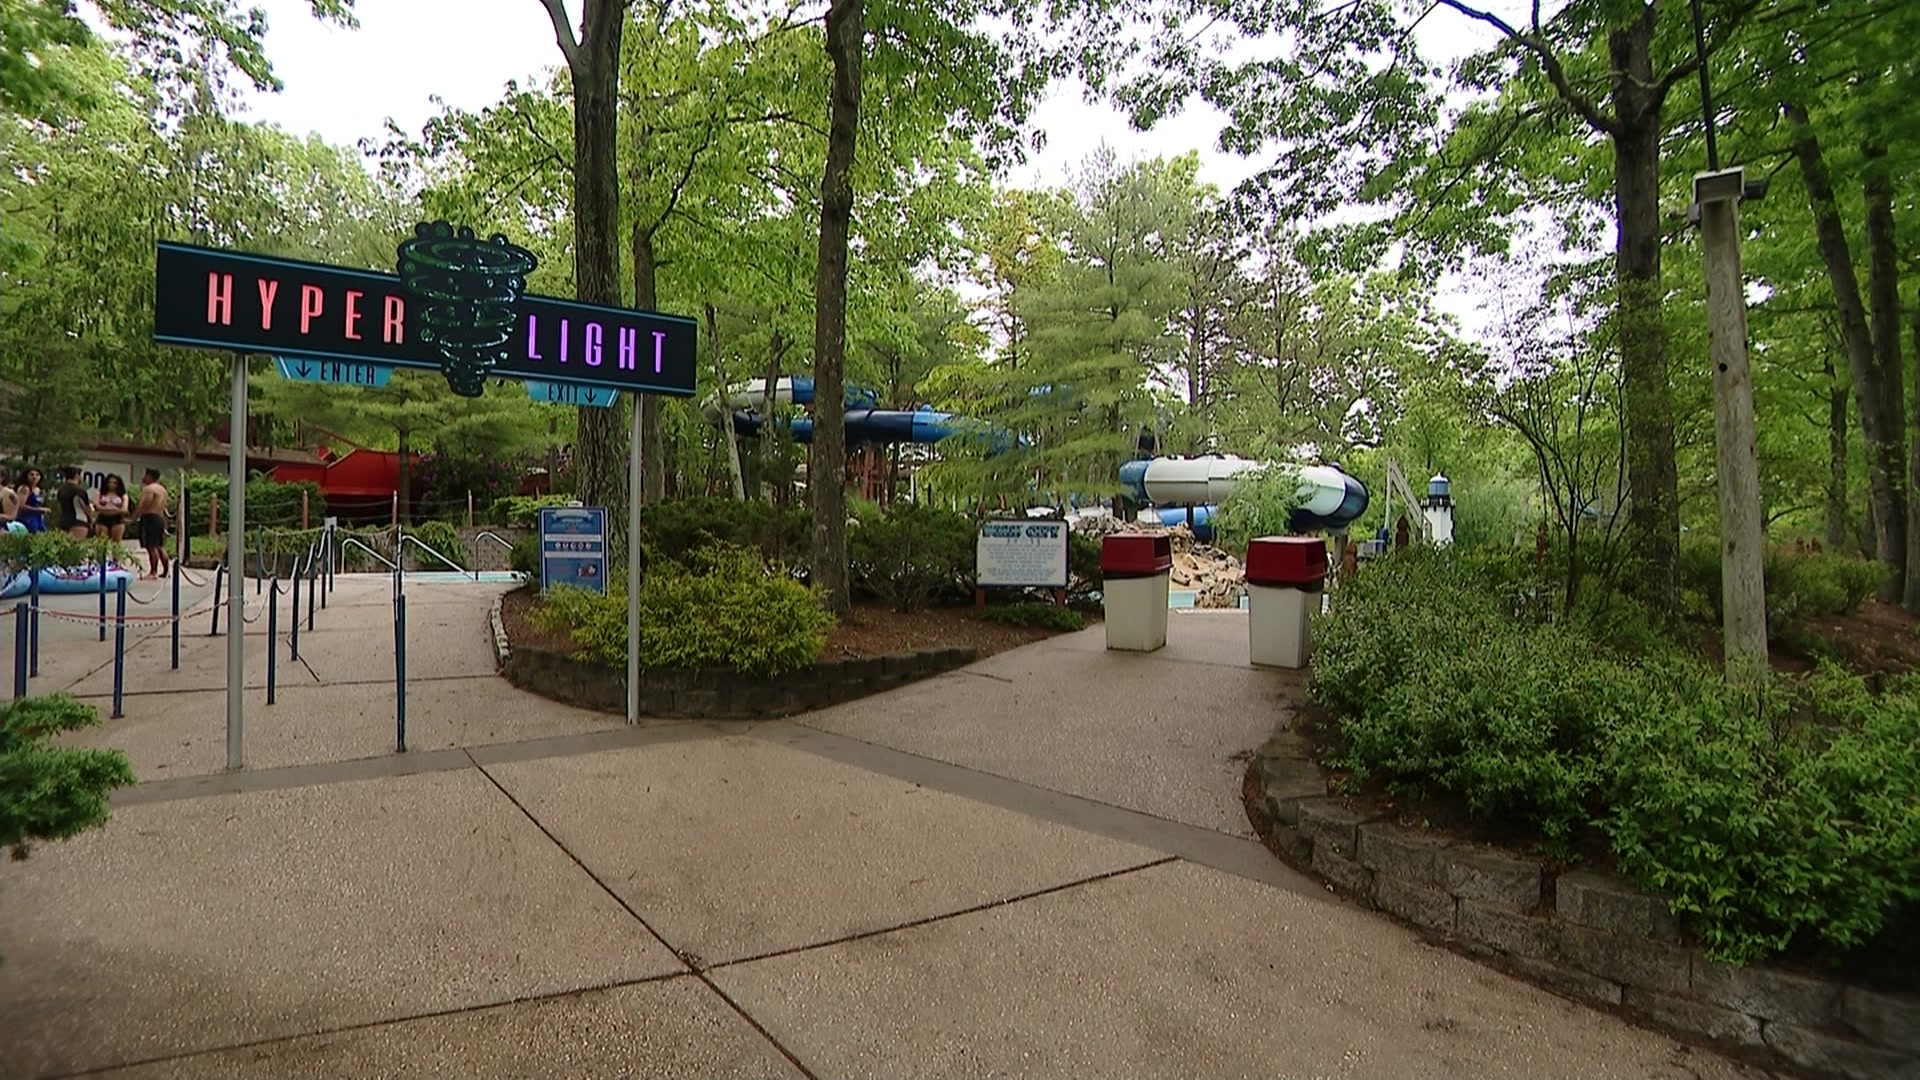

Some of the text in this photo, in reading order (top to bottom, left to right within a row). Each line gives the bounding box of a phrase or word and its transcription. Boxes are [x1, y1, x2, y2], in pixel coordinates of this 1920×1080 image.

[207, 272, 666, 374] HYPER LIGHT
[320, 361, 375, 385] ENTER
[548, 384, 579, 402] EXIT
